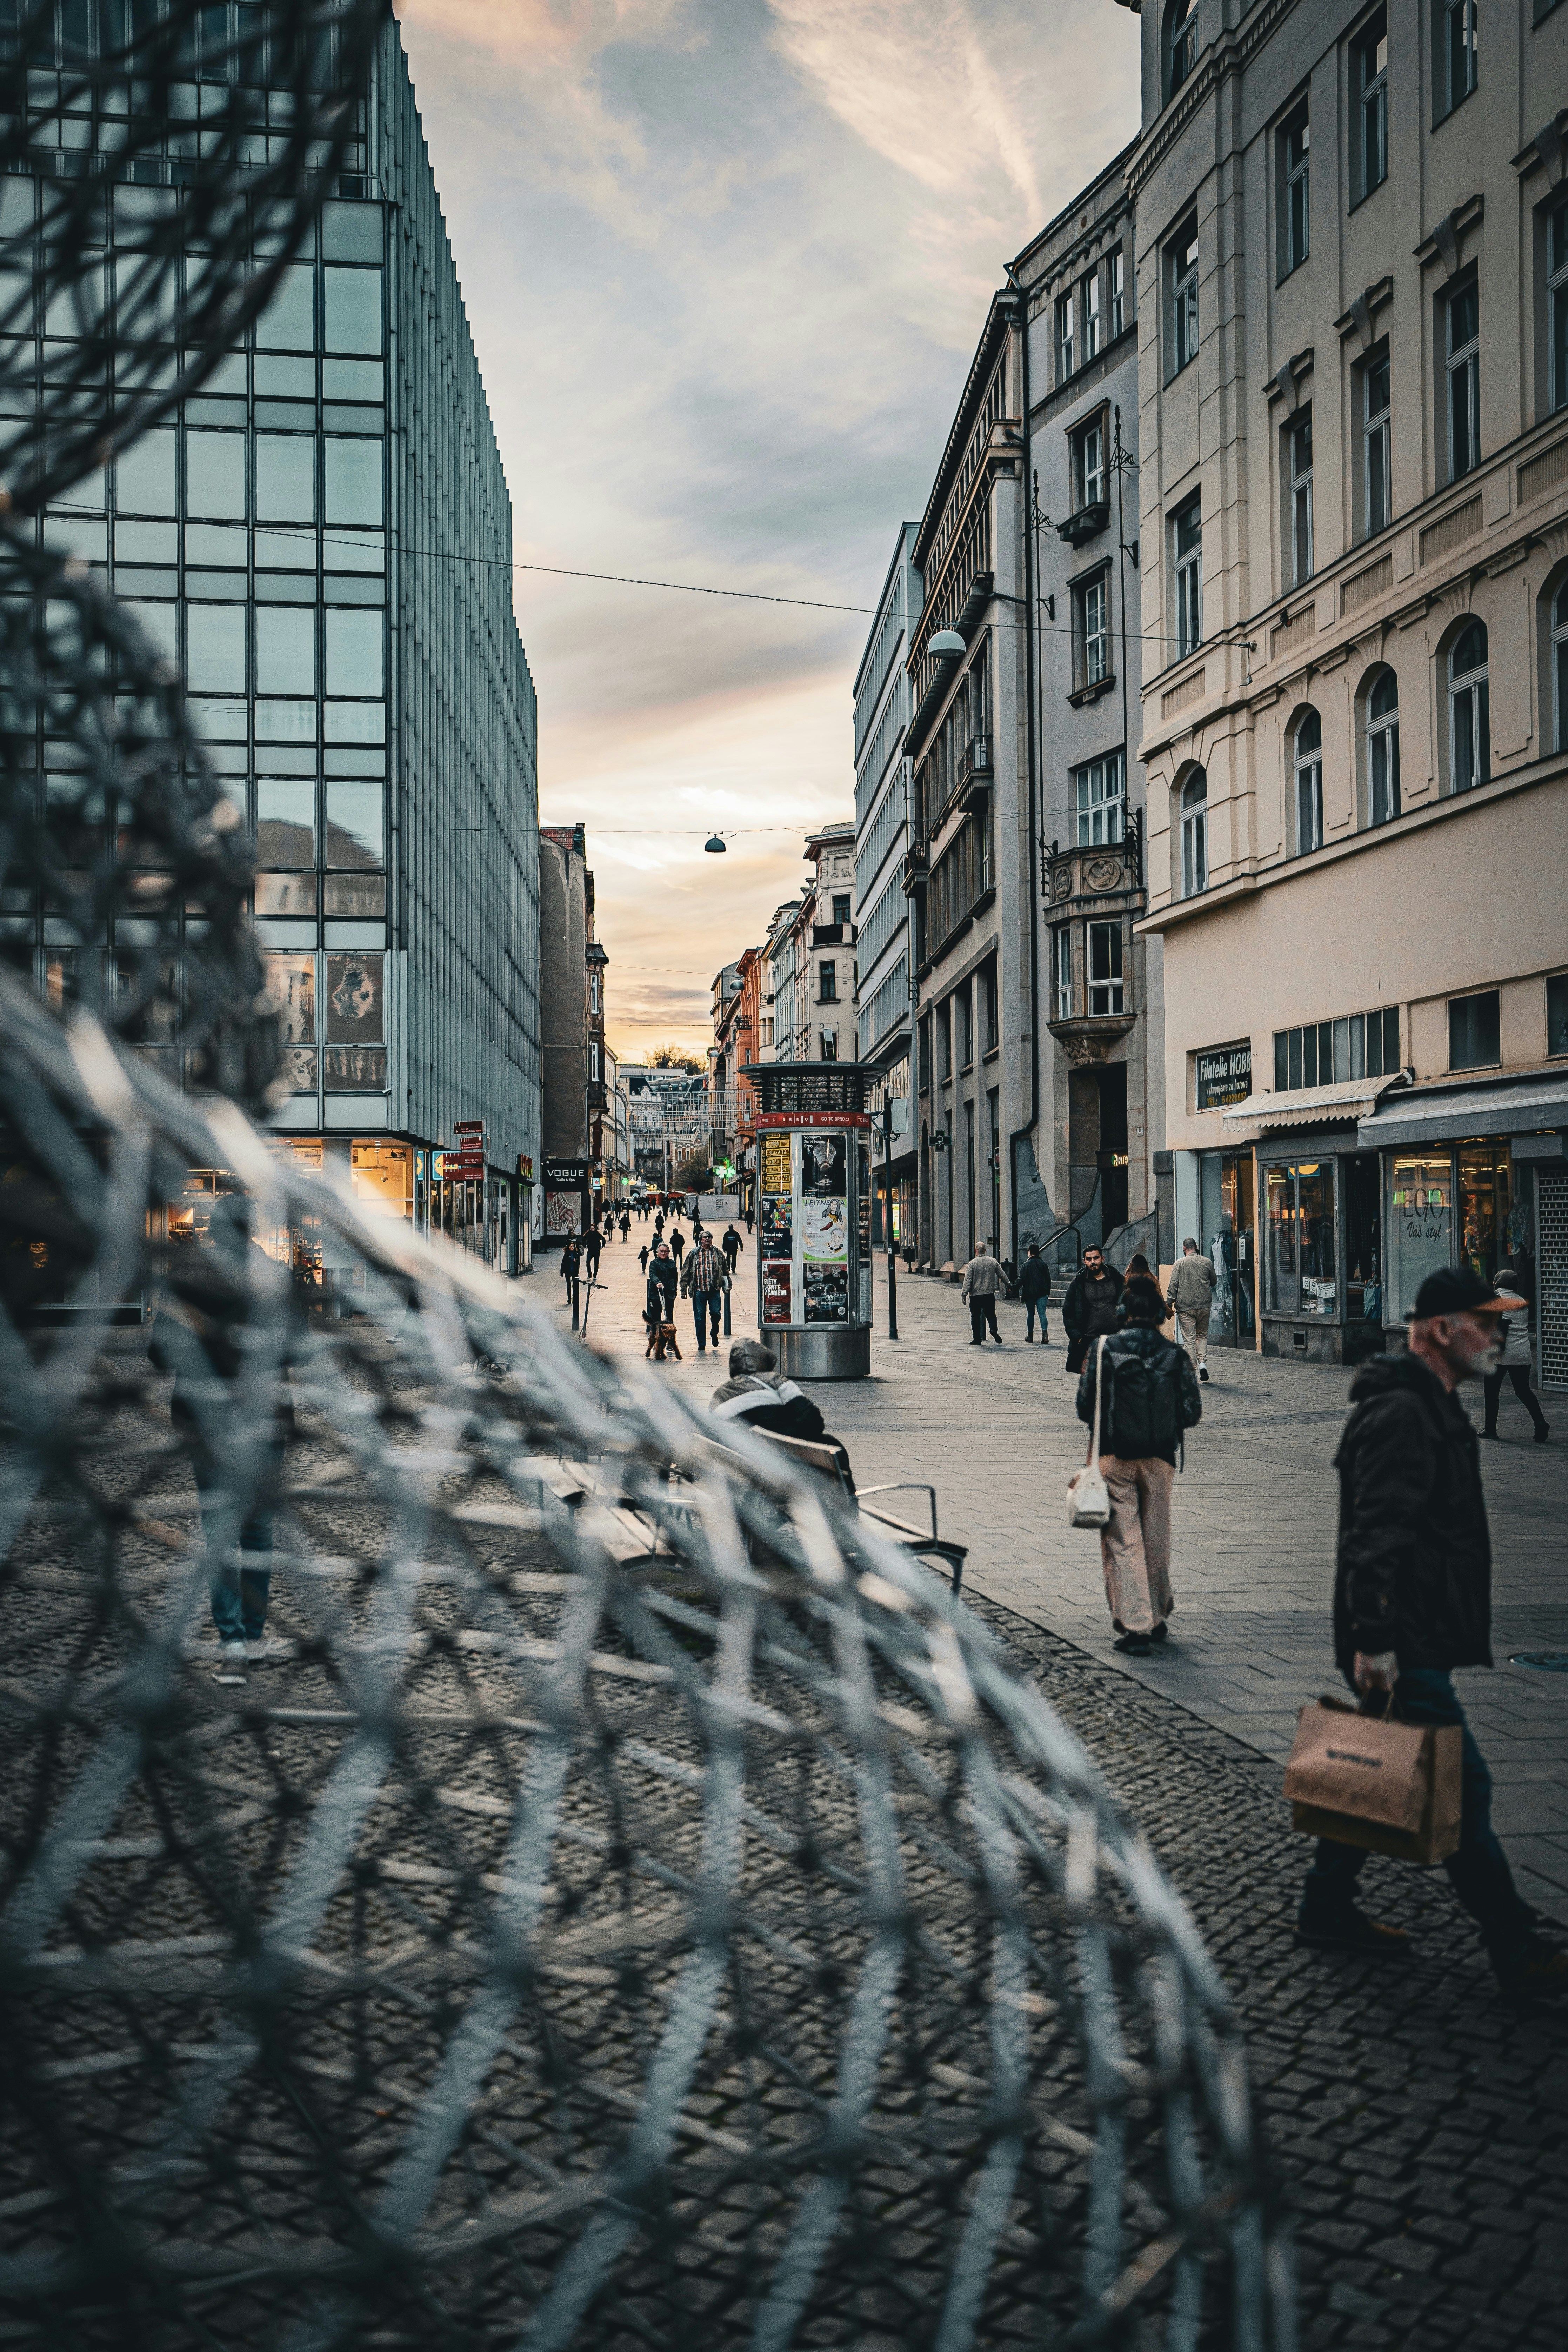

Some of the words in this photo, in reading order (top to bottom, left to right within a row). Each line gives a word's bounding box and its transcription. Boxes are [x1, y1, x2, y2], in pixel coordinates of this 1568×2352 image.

[1200, 1056, 1228, 1081] Filatelie
[1206, 1083, 1228, 1097] vykupujeme
[1234, 1078, 1248, 1090] hotové
[1222, 1096, 1225, 1104] 5
[1226, 1092, 1246, 1103] 42211997
[1403, 1188, 1444, 1223] EGO
[1407, 1221, 1423, 1238] Váš
[1426, 1222, 1442, 1243] styl
